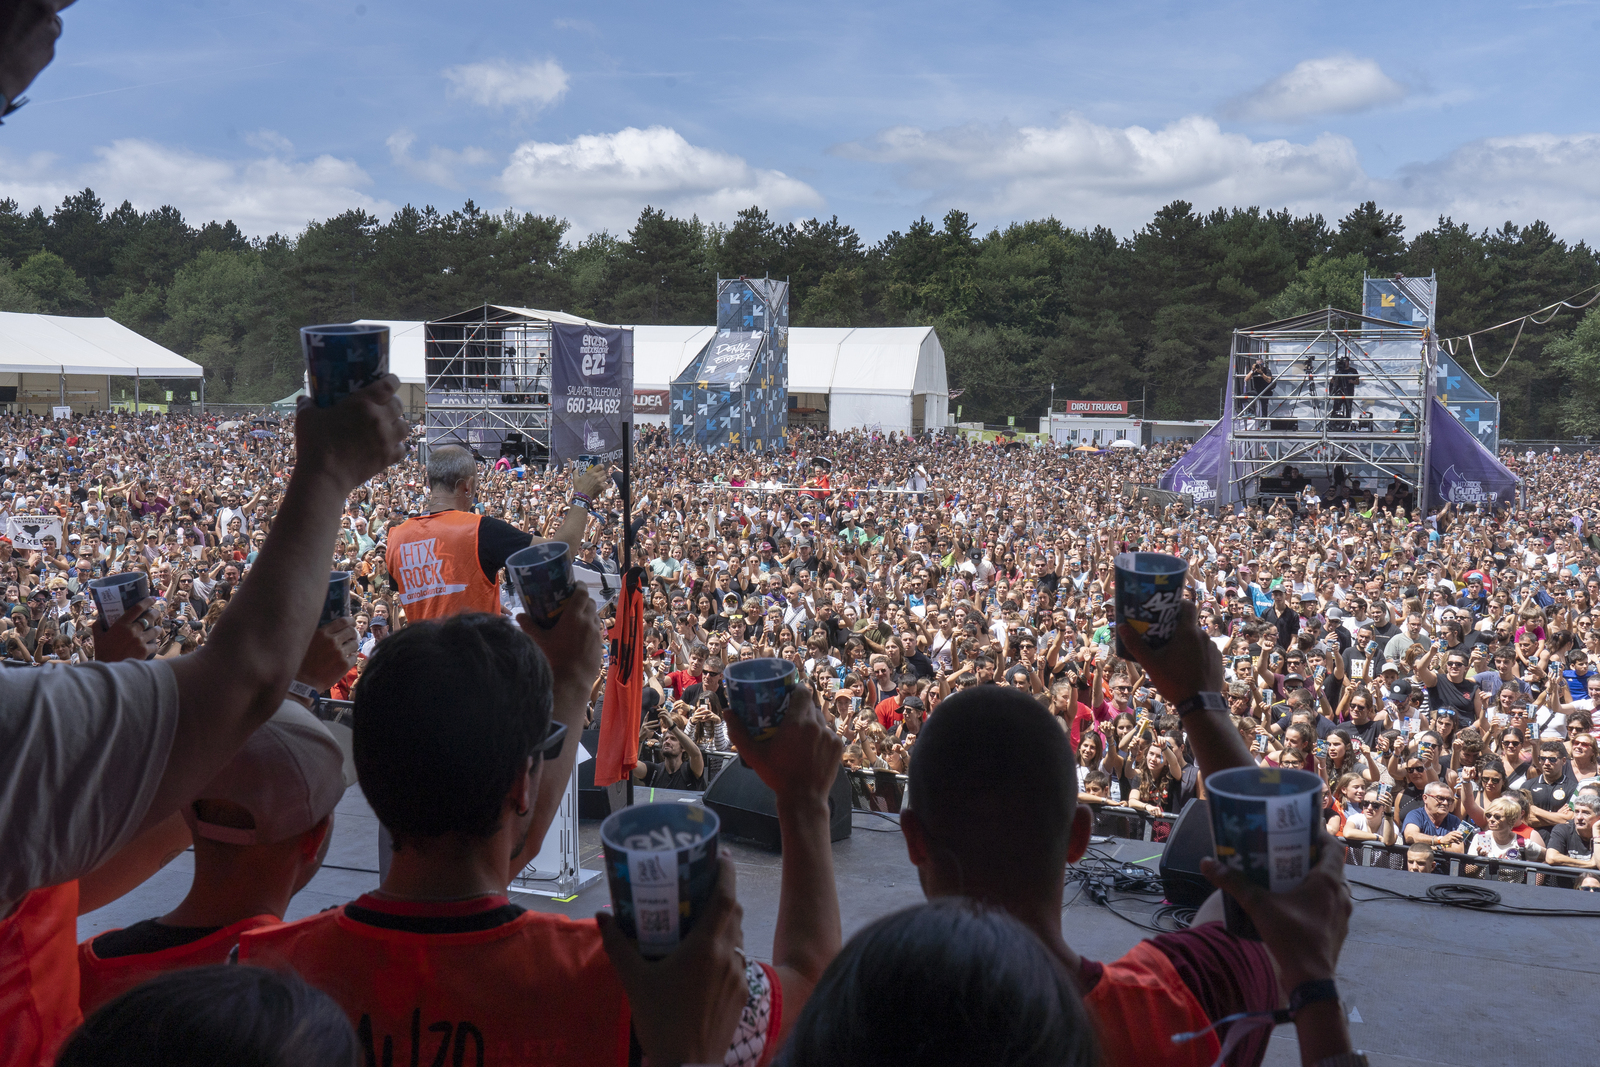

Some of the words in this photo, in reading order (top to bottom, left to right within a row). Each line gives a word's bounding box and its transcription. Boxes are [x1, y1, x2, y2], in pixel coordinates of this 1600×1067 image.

[716, 342, 754, 355] DENAK
[582, 353, 606, 376] ez!
[567, 385, 592, 397] SALAKETA
[592, 386, 622, 398] TELEFONOA
[566, 397, 585, 413] 660
[585, 398, 604, 414] 344
[604, 398, 621, 414] 692
[633, 394, 662, 406] LDEA
[1071, 402, 1090, 411] DIRU
[1091, 402, 1123, 412] TRUKEA
[1185, 486, 1207, 494] Gune
[1455, 486, 1480, 495] Gune
[403, 541, 435, 566] HTX
[403, 561, 441, 590] ROCK
